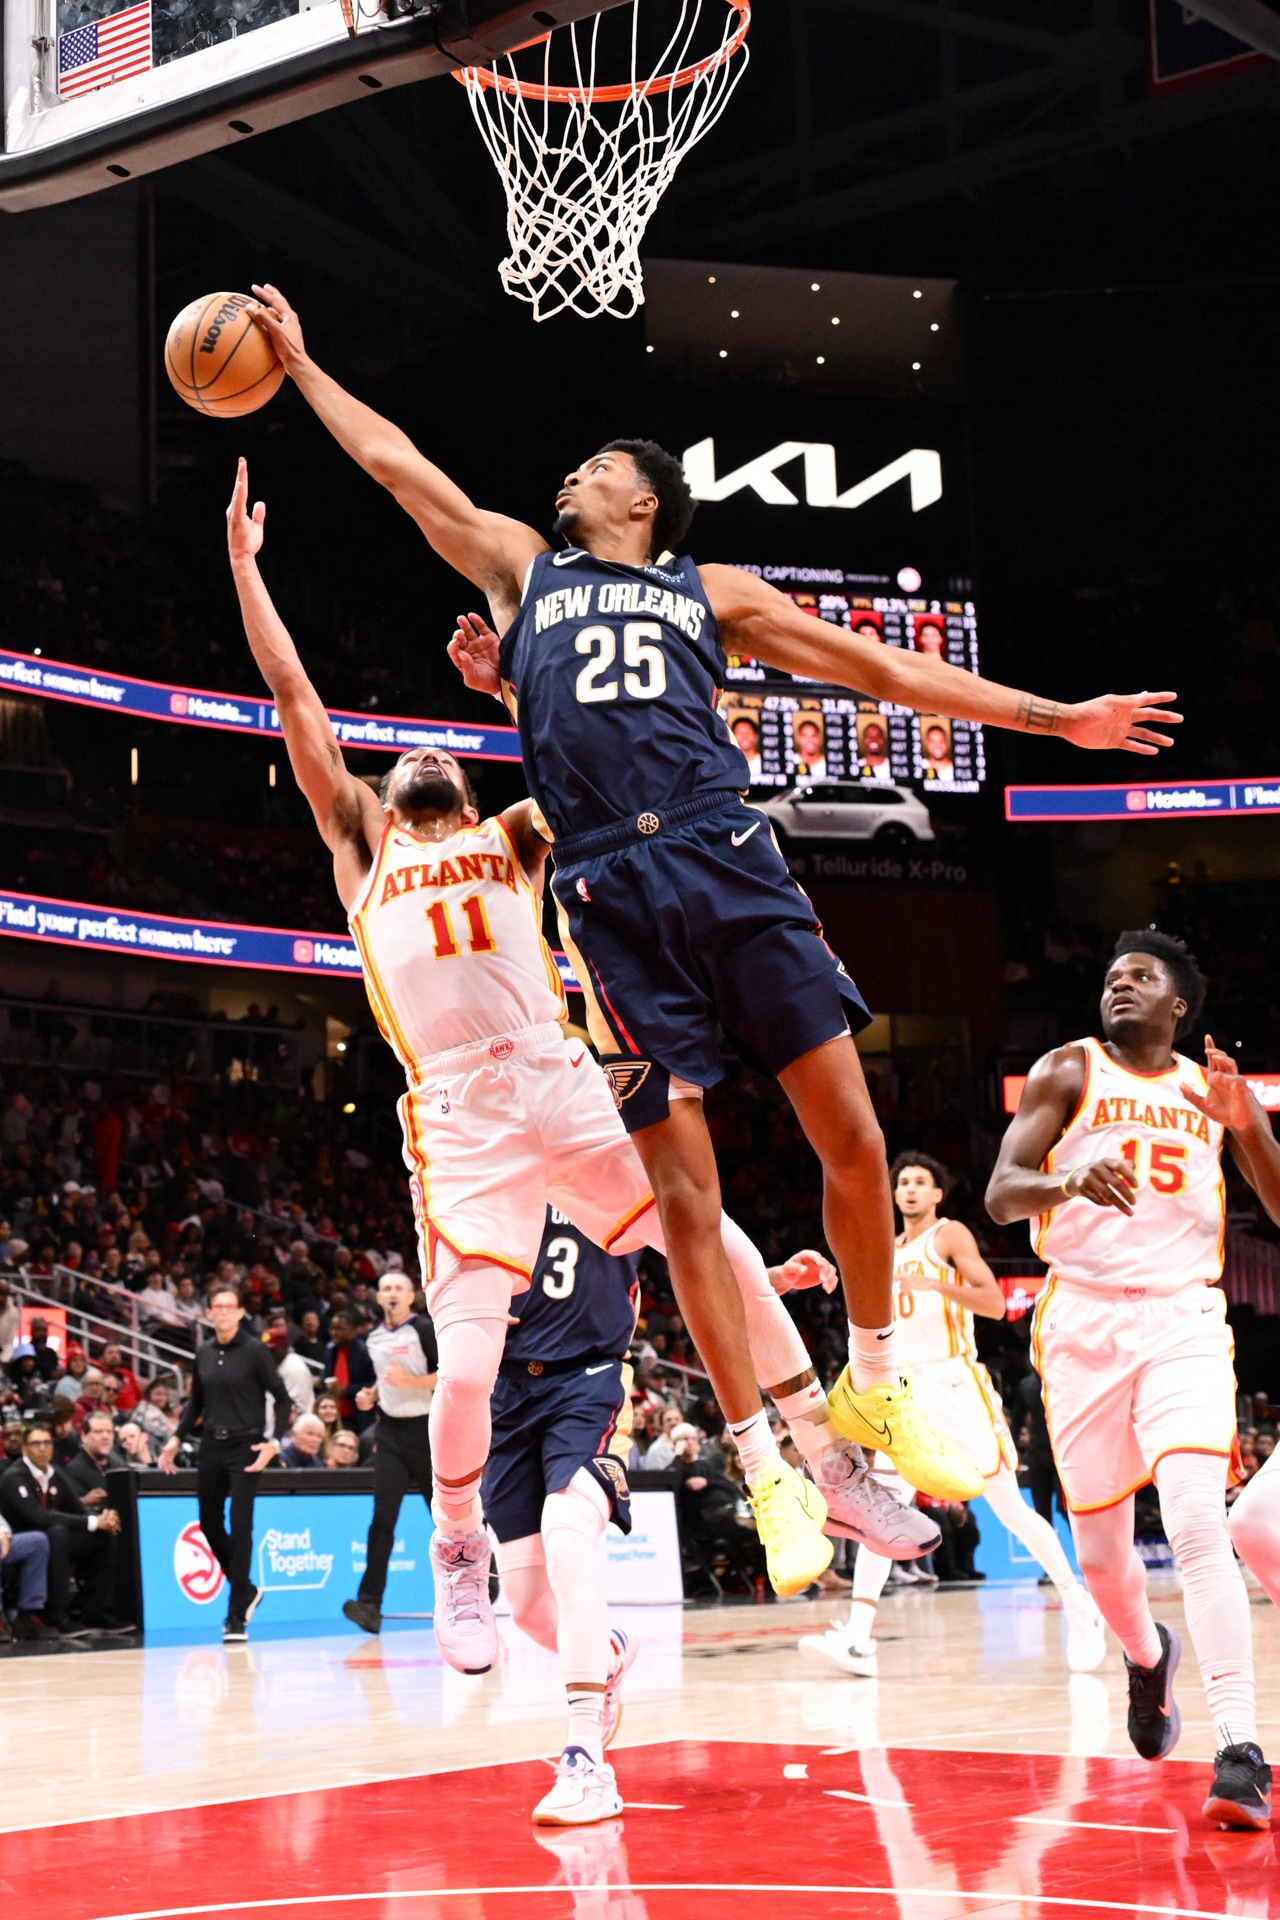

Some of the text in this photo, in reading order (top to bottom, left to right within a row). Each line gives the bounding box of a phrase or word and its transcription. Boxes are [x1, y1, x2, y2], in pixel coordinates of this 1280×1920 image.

[682, 437, 943, 513] KIA
[764, 566, 844, 584] CAPTIONING
[535, 583, 706, 641] NEW ORLEANS
[0, 660, 41, 687] erfect
[575, 622, 667, 704] 25
[188, 697, 253, 723] Hotels
[341, 721, 395, 744] perfect
[1147, 788, 1223, 810] Hotels
[381, 852, 518, 908] ATLANTA
[811, 855, 902, 880] Telluride
[908, 858, 967, 882] X-Pro
[0, 902, 35, 928] Find
[37, 911, 77, 934] your
[78, 917, 138, 941] perfect
[139, 927, 238, 955] somewhere
[425, 894, 497, 961] 11
[489, 1041, 515, 1057] HAWKS
[1091, 1096, 1211, 1146] ATLANTA
[1119, 1137, 1189, 1197] 15
[542, 1236, 579, 1300] 3
[266, 1527, 312, 1551] Stand
[267, 1550, 335, 1577] Together
